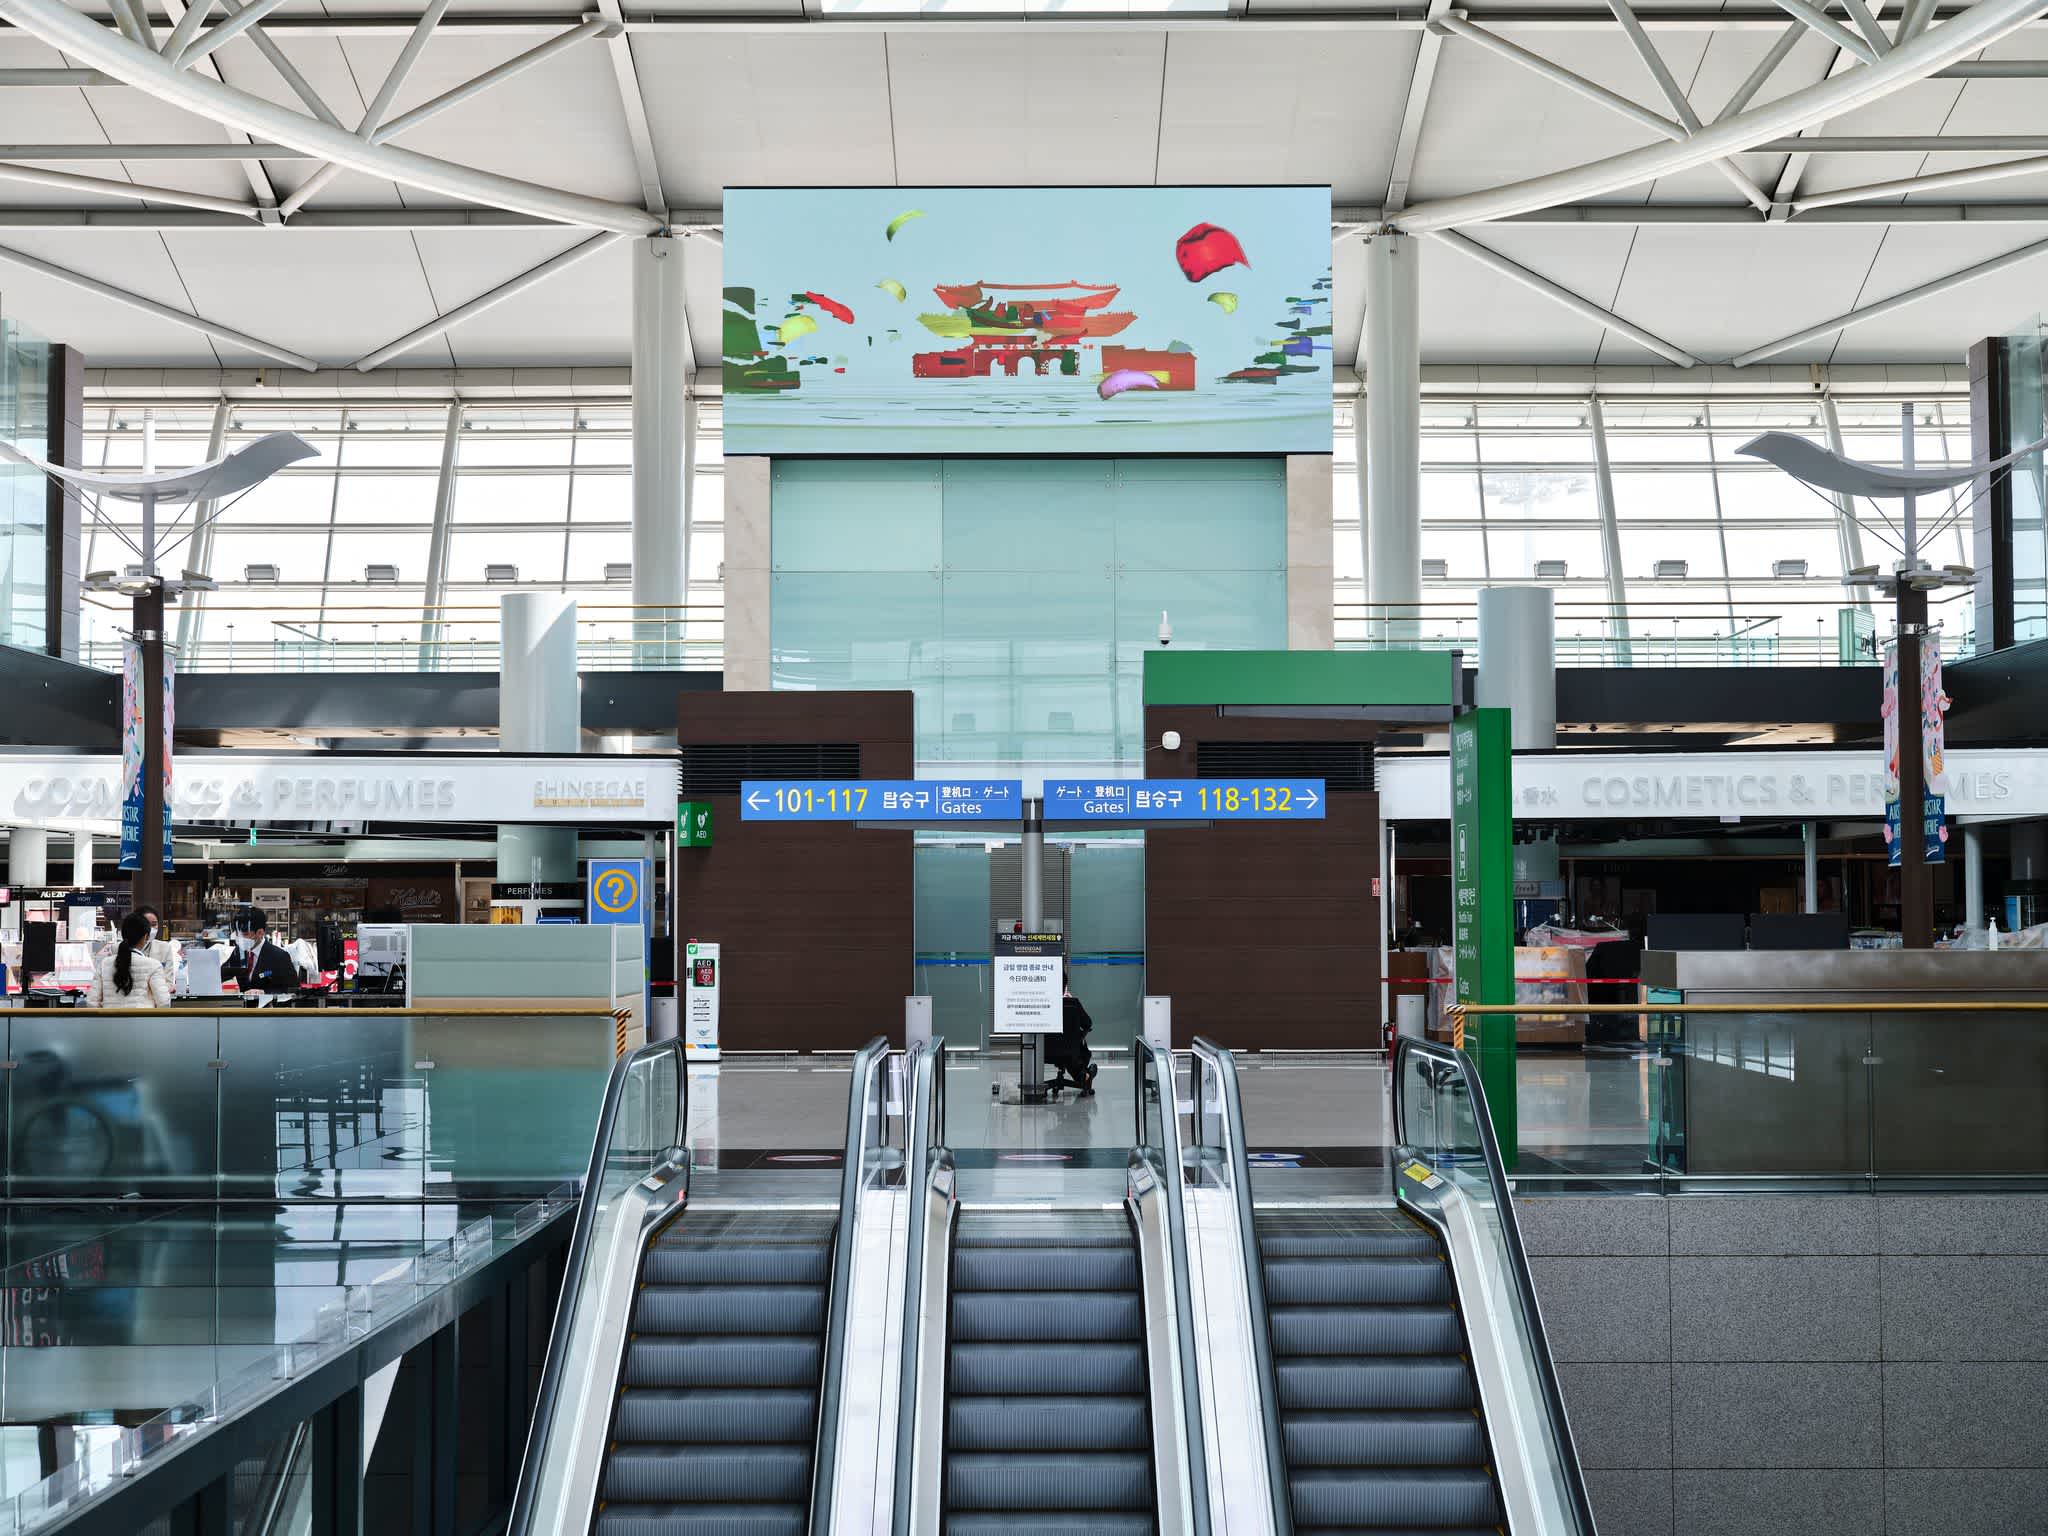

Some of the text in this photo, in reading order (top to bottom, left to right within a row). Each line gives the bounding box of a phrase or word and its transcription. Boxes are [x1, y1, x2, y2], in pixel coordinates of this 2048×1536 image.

[233, 779, 263, 809] &
[272, 777, 457, 809] PERFUMES
[534, 781, 645, 798] SHINSEGAE
[1583, 770, 2011, 807] COSMETICS & PERMES
[775, 788, 868, 813] 101-117
[883, 791, 929, 810] 탑승구
[941, 802, 982, 815] Gates
[1083, 801, 1124, 814] Gates
[1136, 790, 1183, 809] 탑승구
[1198, 787, 1292, 812] 118-132
[695, 830, 707, 839] AED
[507, 887, 553, 896] PERFUMES
